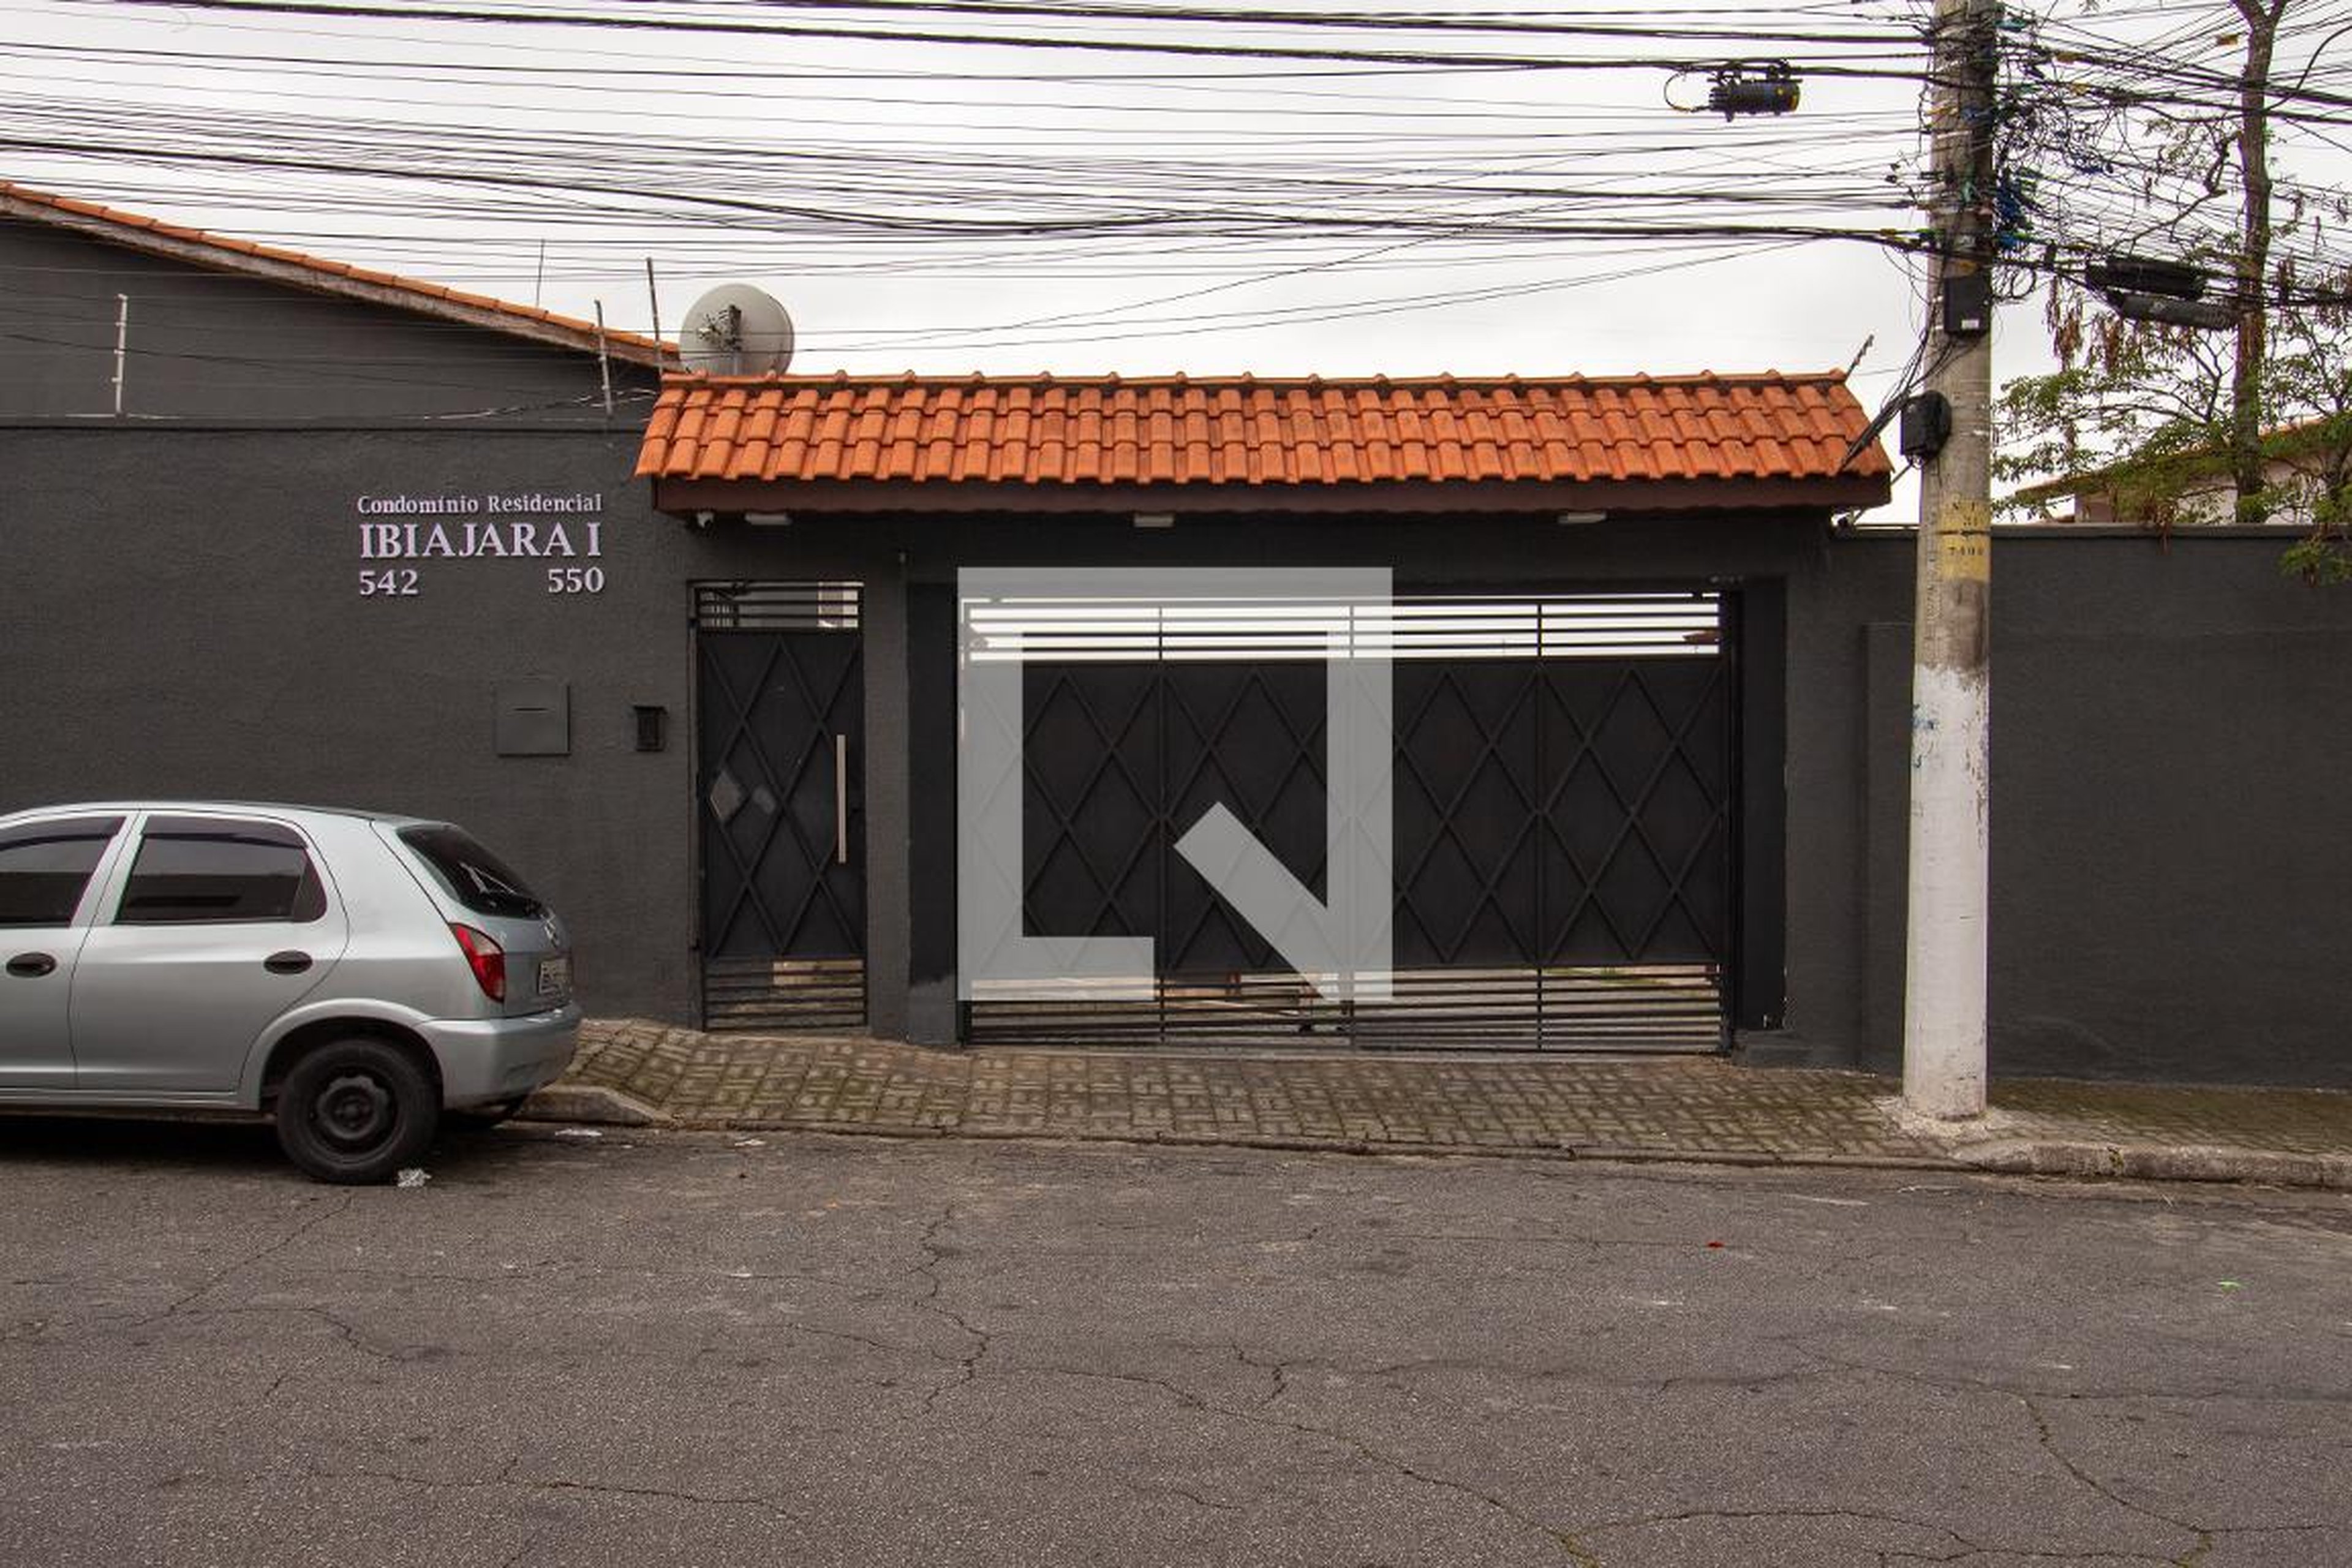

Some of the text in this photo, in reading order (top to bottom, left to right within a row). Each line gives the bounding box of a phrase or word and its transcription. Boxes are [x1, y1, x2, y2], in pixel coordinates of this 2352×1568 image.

[488, 493, 602, 512] Residencial
[359, 522, 601, 558] IBIAJARA I
[360, 569, 419, 595] 542
[548, 567, 605, 593] 550
